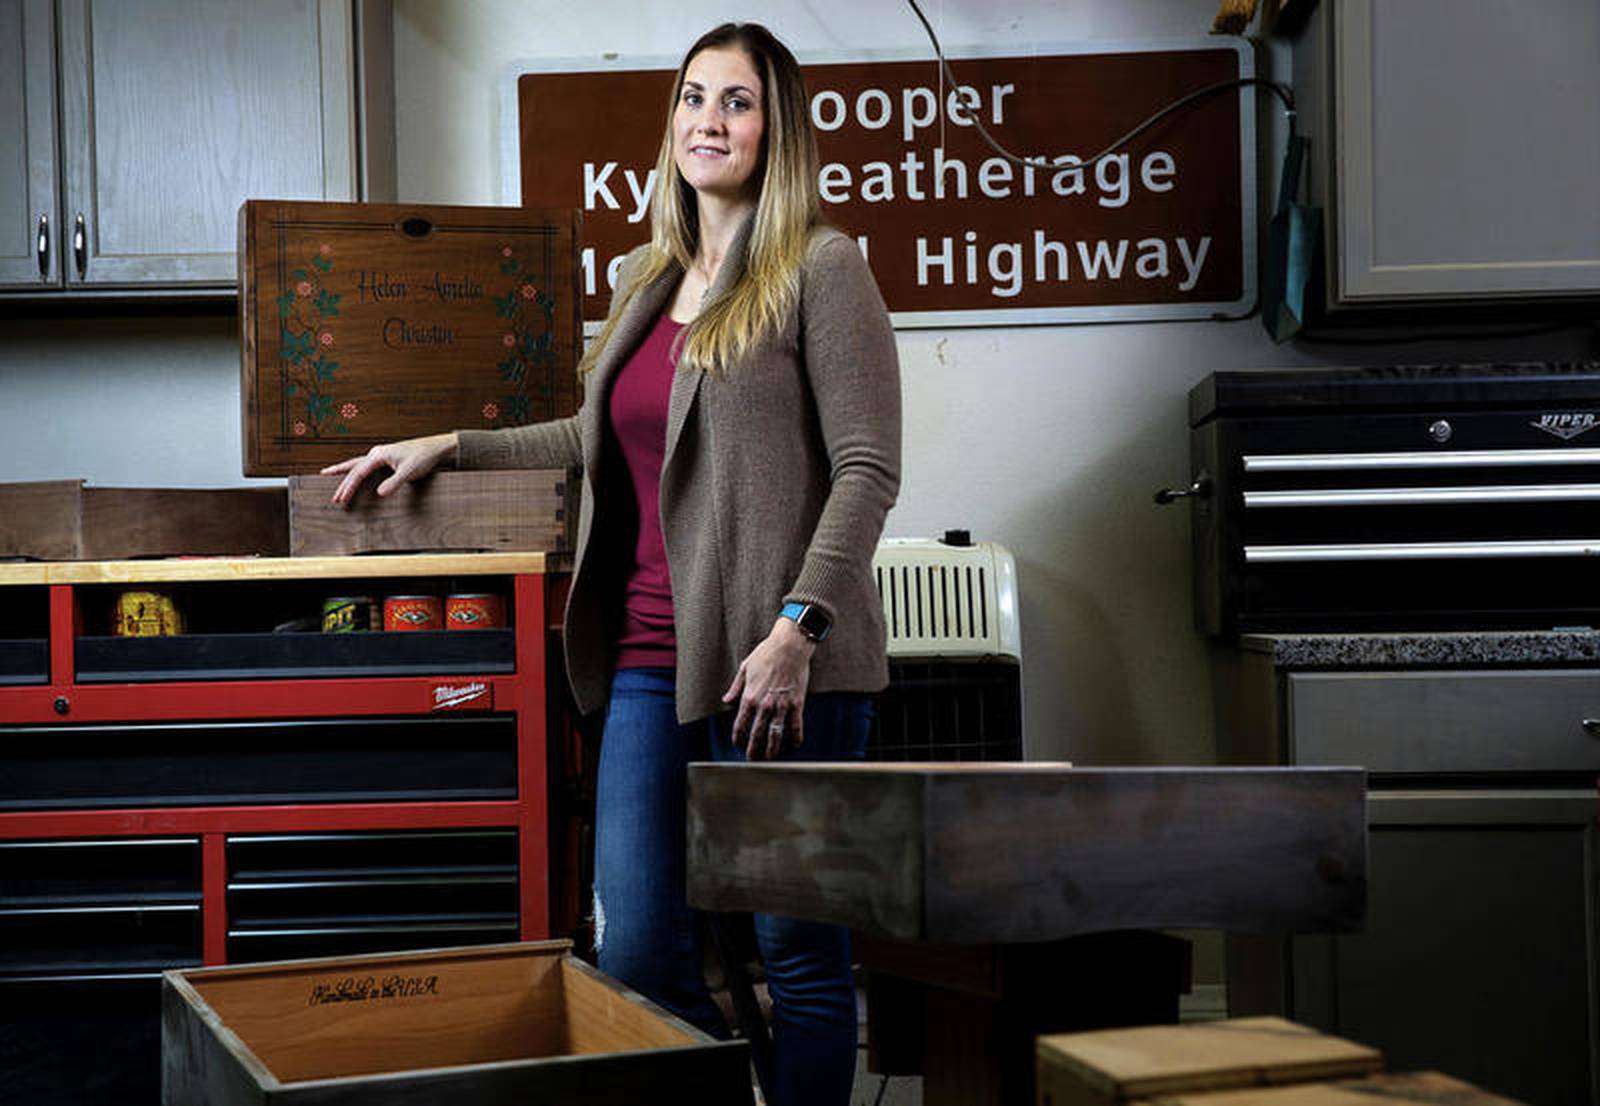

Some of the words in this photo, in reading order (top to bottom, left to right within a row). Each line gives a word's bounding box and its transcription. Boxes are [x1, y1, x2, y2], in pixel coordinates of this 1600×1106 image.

[810, 83, 1015, 142] ooper
[583, 162, 658, 223] Ky
[817, 147, 1176, 208] eatherage
[916, 230, 1212, 297] Highway
[1540, 413, 1596, 428] VIPER
